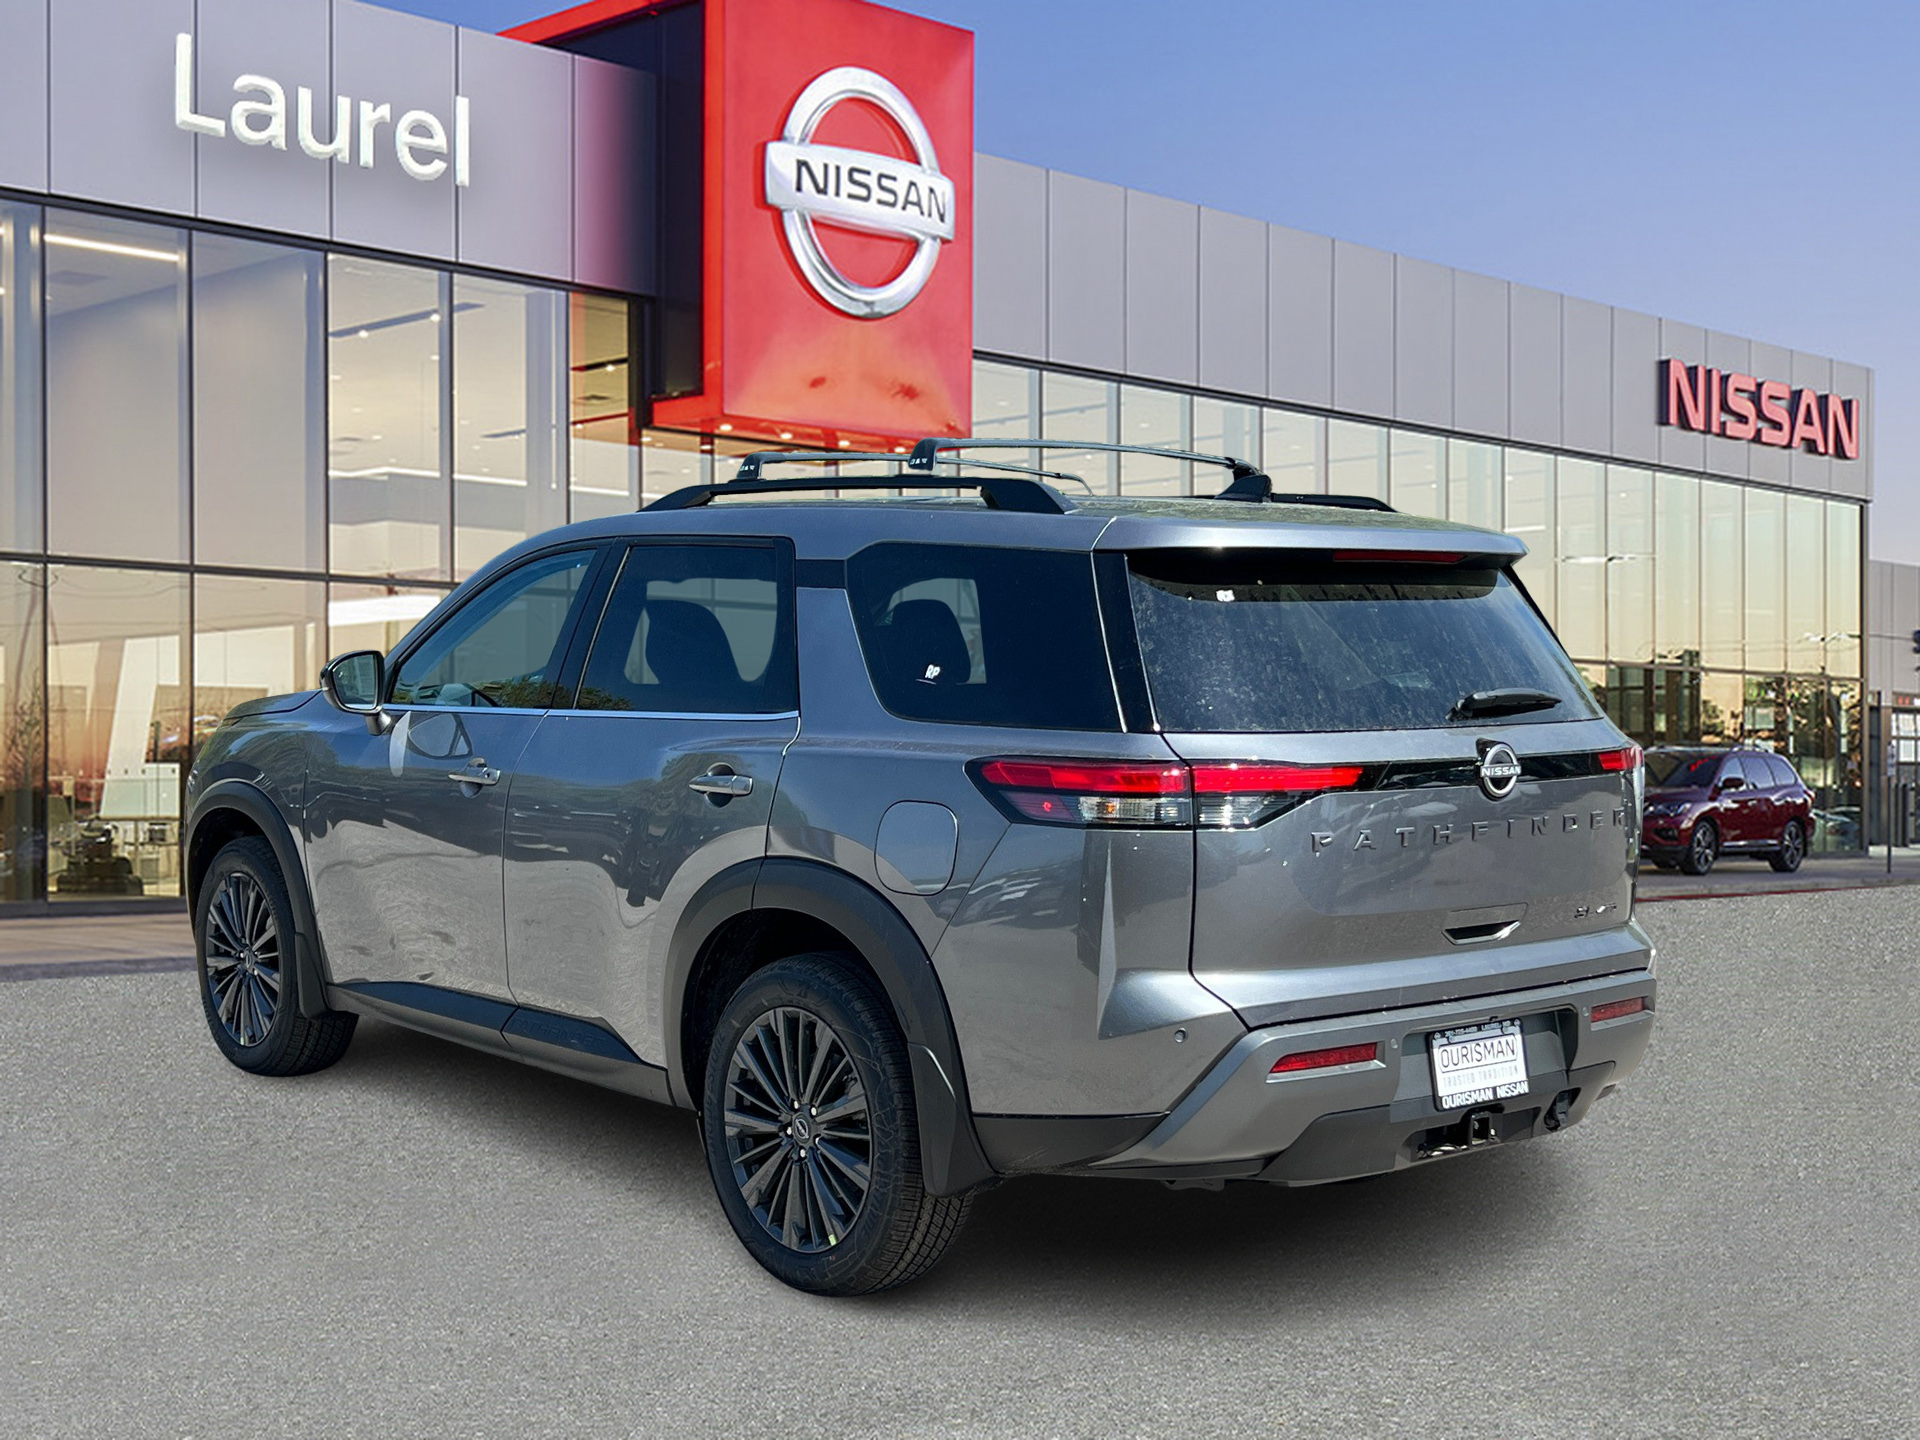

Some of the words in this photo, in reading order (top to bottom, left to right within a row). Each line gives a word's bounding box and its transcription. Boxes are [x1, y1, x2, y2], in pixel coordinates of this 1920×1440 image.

[175, 32, 469, 187] Laurel
[794, 158, 947, 223] NISSAN
[1657, 358, 1860, 460] NISSAN
[1481, 765, 1522, 777] NISSAN
[1310, 806, 1626, 854] PATHFINDER
[1440, 1038, 1516, 1069] OURISMAN
[1442, 1087, 1494, 1109] OURISMAN
[1496, 1081, 1529, 1099] NISSAN
